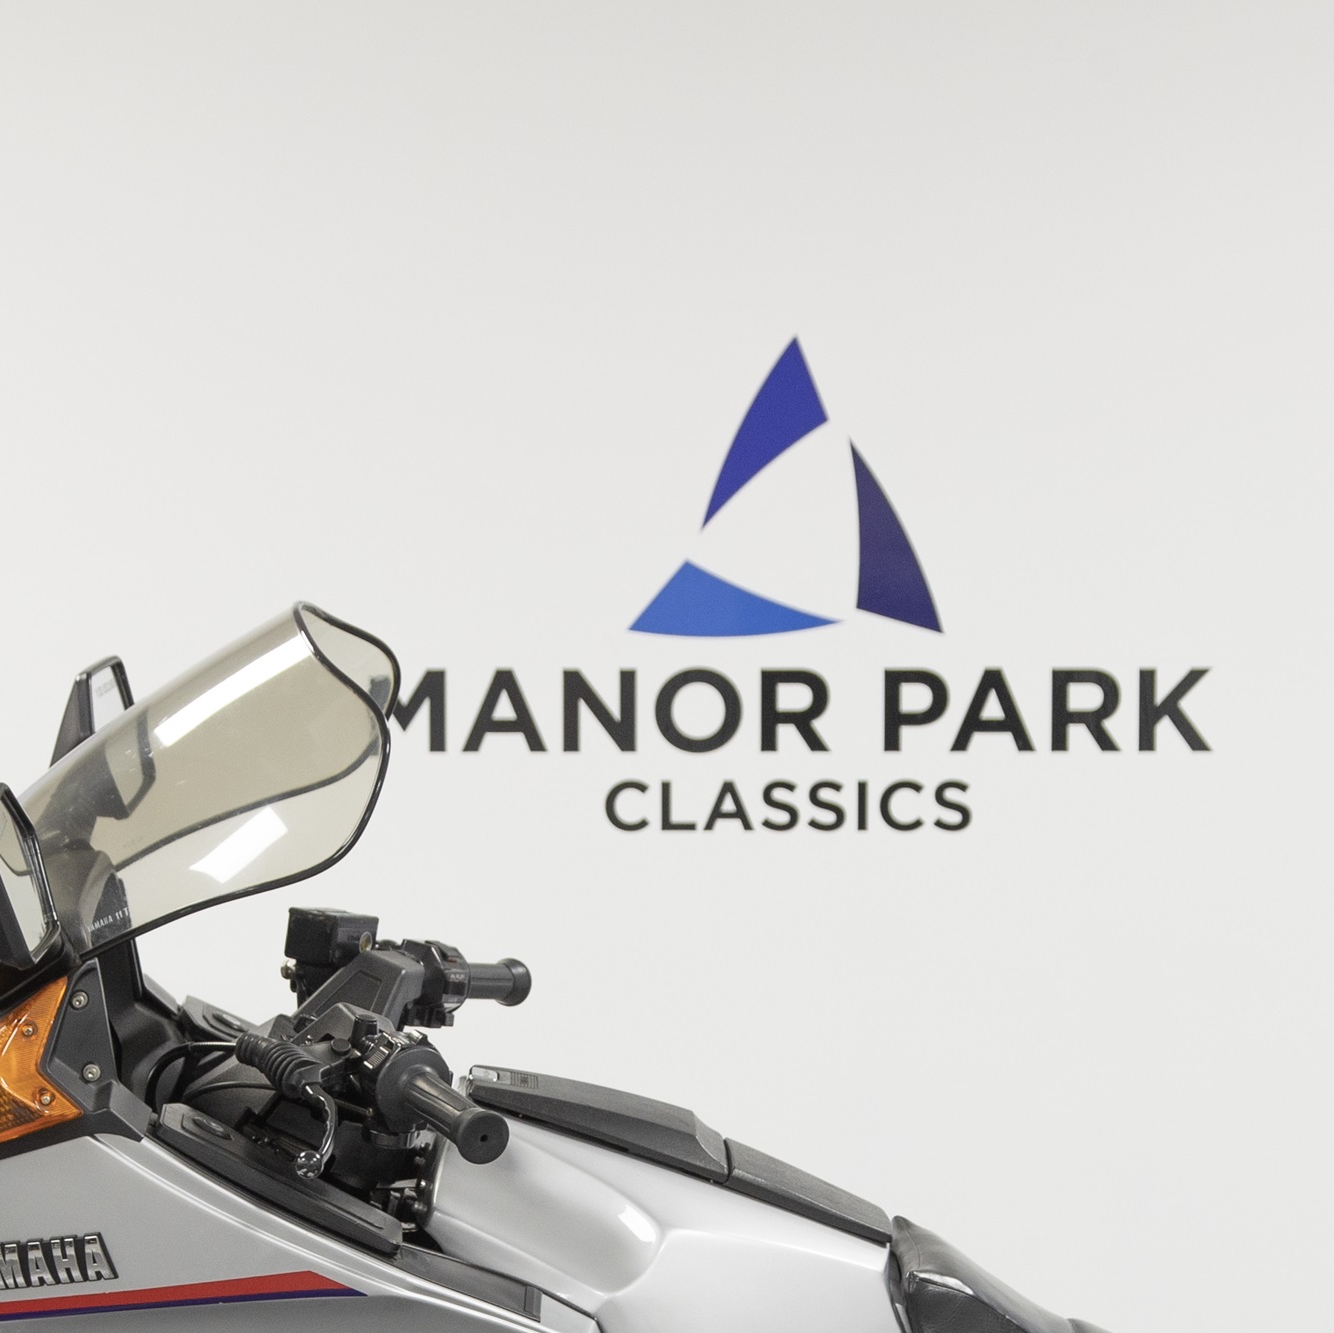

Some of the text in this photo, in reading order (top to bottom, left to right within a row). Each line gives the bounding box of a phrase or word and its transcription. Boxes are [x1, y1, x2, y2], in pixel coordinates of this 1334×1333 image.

[369, 668, 1211, 753] MANOR PARK
[604, 780, 972, 832] CLASSICS
